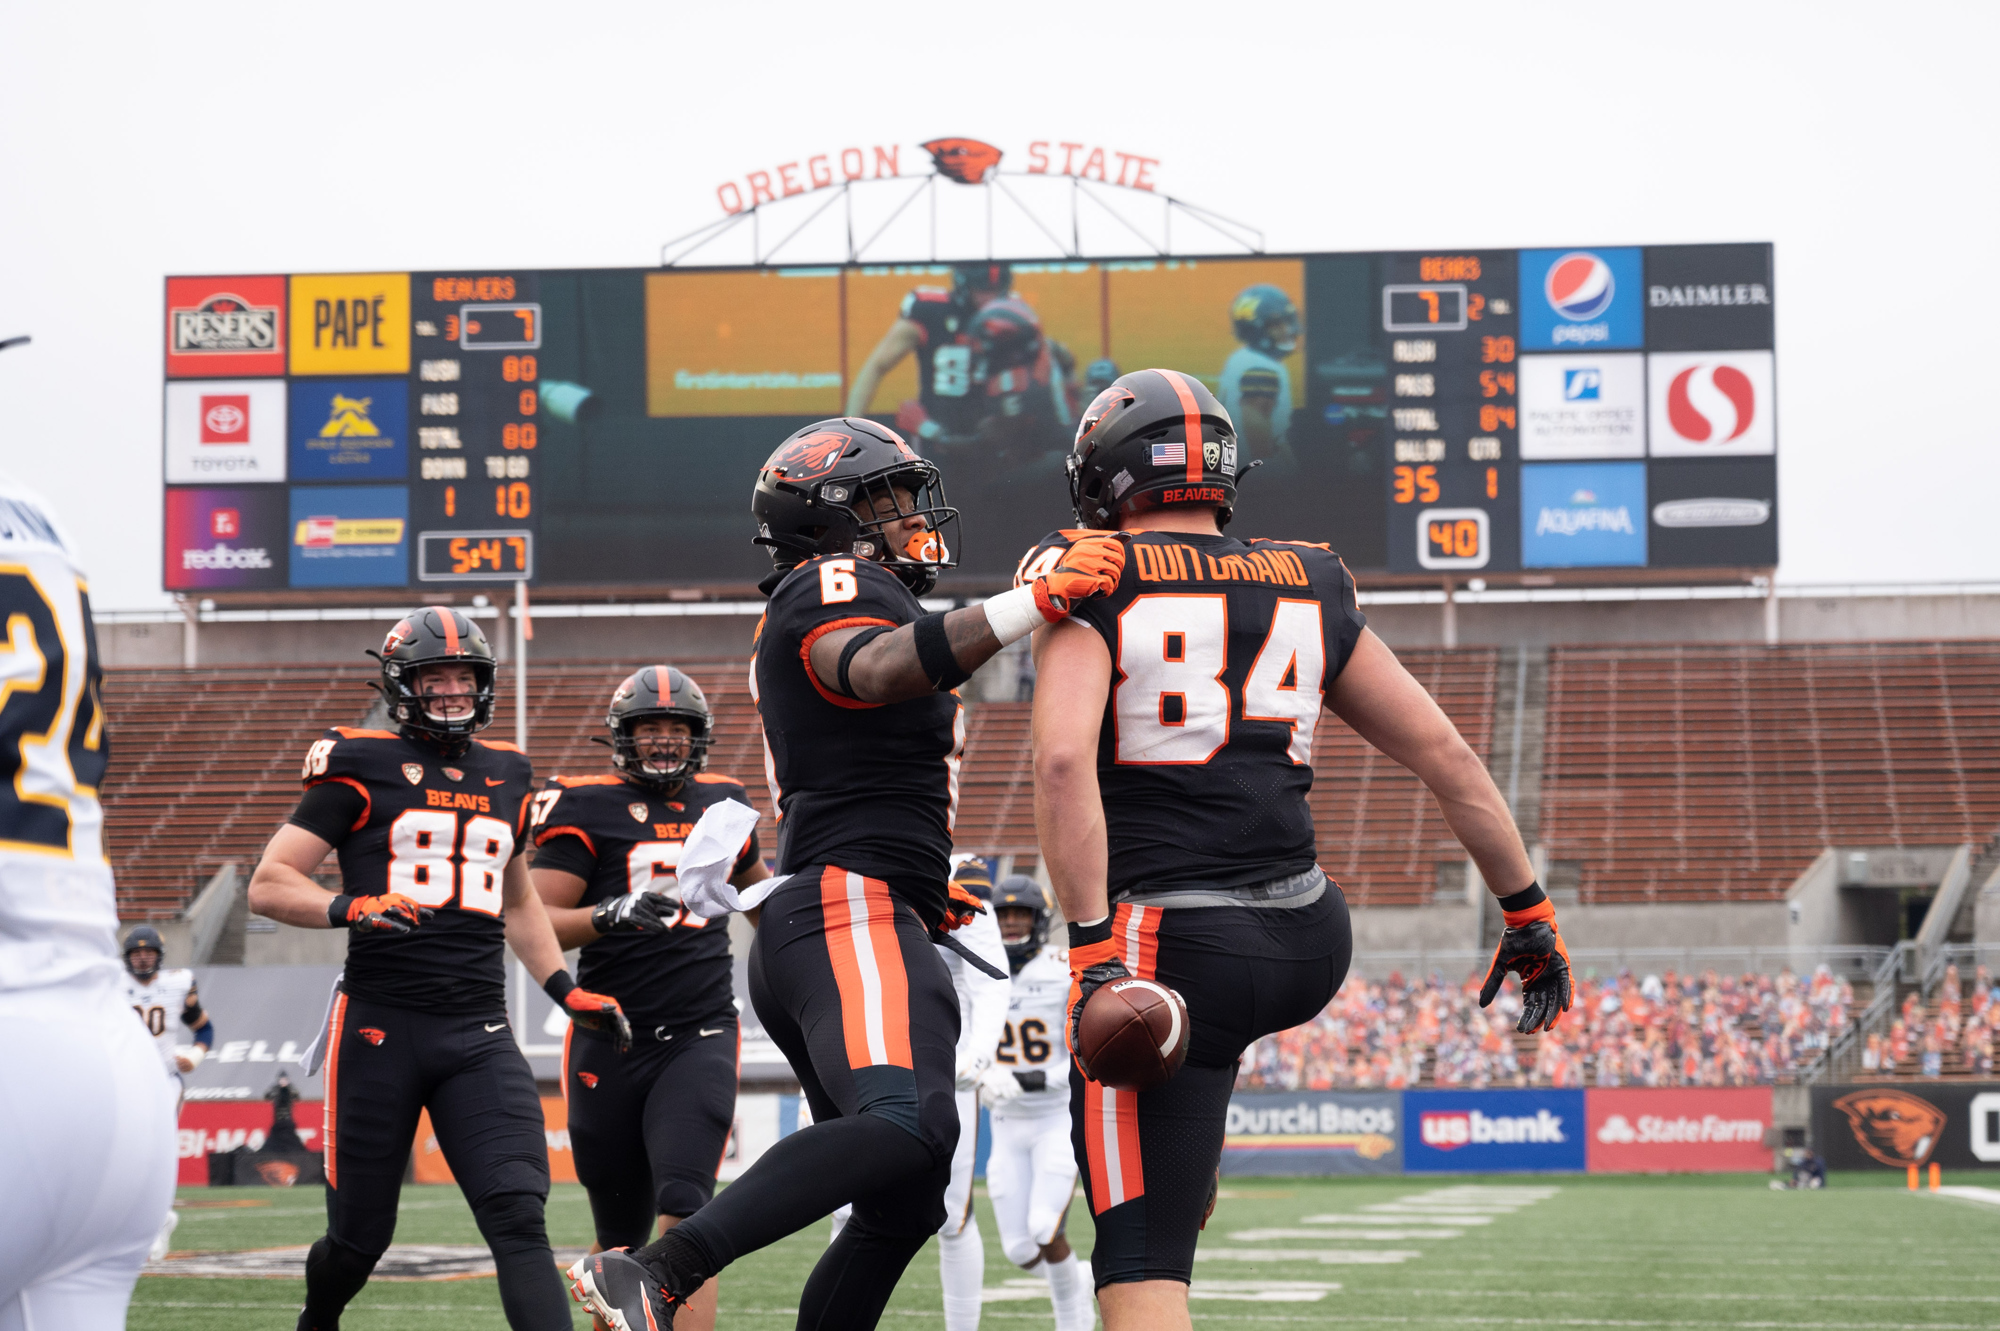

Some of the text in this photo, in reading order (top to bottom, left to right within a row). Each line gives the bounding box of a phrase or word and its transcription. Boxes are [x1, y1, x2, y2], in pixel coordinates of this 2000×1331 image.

[716, 141, 1160, 215] OREGON STATE
[1420, 255, 1482, 282] BEARS
[433, 276, 516, 301] BEAVERS
[1649, 283, 1772, 308] DAIMLER
[1417, 289, 1439, 324] 7
[1467, 292, 1485, 321] 2
[314, 294, 386, 348] PAPÉ
[444, 314, 460, 341] 3
[513, 309, 534, 342] 7
[1552, 323, 1609, 345] pepsi
[1393, 339, 1437, 363] RUSH
[1481, 335, 1515, 363] 30
[502, 354, 537, 382] 80
[1395, 373, 1435, 397] PASS
[1479, 369, 1515, 398] 54
[421, 392, 459, 415] PASS
[519, 388, 537, 416] 0
[1392, 407, 1439, 432] TOTAL
[502, 422, 537, 450] 80
[192, 456, 259, 472] TOYOTA
[421, 457, 467, 480] DOWN
[1162, 487, 1225, 503] BEAVERS
[1393, 465, 1440, 503] 35
[1486, 466, 1498, 500] 1
[445, 485, 456, 517] 1
[496, 481, 531, 518] 10
[1536, 505, 1636, 536] AQUAFINA
[1429, 519, 1478, 557] 40
[449, 536, 526, 574] 5:47
[819, 559, 858, 606] 6
[1114, 594, 1327, 765] 84
[425, 788, 491, 813] BEAVS
[653, 822, 698, 839] BEA
[388, 808, 515, 917] 88
[997, 1018, 1052, 1065] 26
